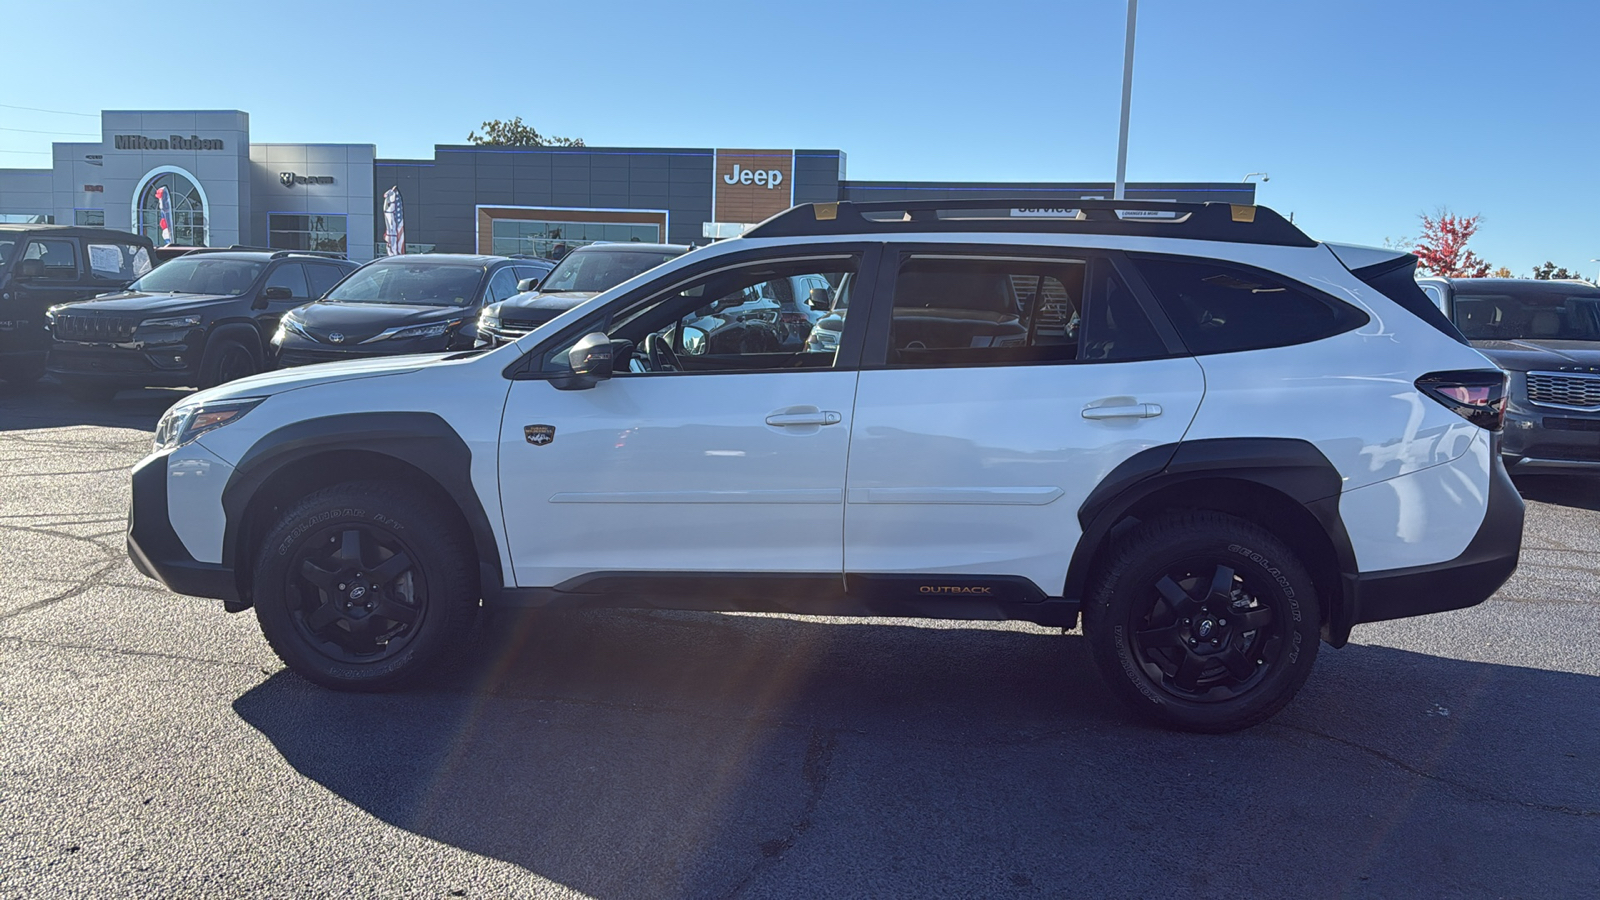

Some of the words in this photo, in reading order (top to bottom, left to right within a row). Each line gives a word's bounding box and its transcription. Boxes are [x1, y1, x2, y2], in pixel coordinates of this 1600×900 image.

[114, 134, 168, 150] Milton
[169, 135, 224, 150] Ruben
[723, 164, 783, 189] Jeep
[278, 508, 366, 556] GEOLANDAR
[373, 513, 404, 531] A/T
[919, 585, 991, 594] OUTBACK
[1228, 543, 1302, 622] GEOLANDAR
[1288, 631, 1302, 664] A/T
[1114, 625, 1161, 704] YOKOHAMA
